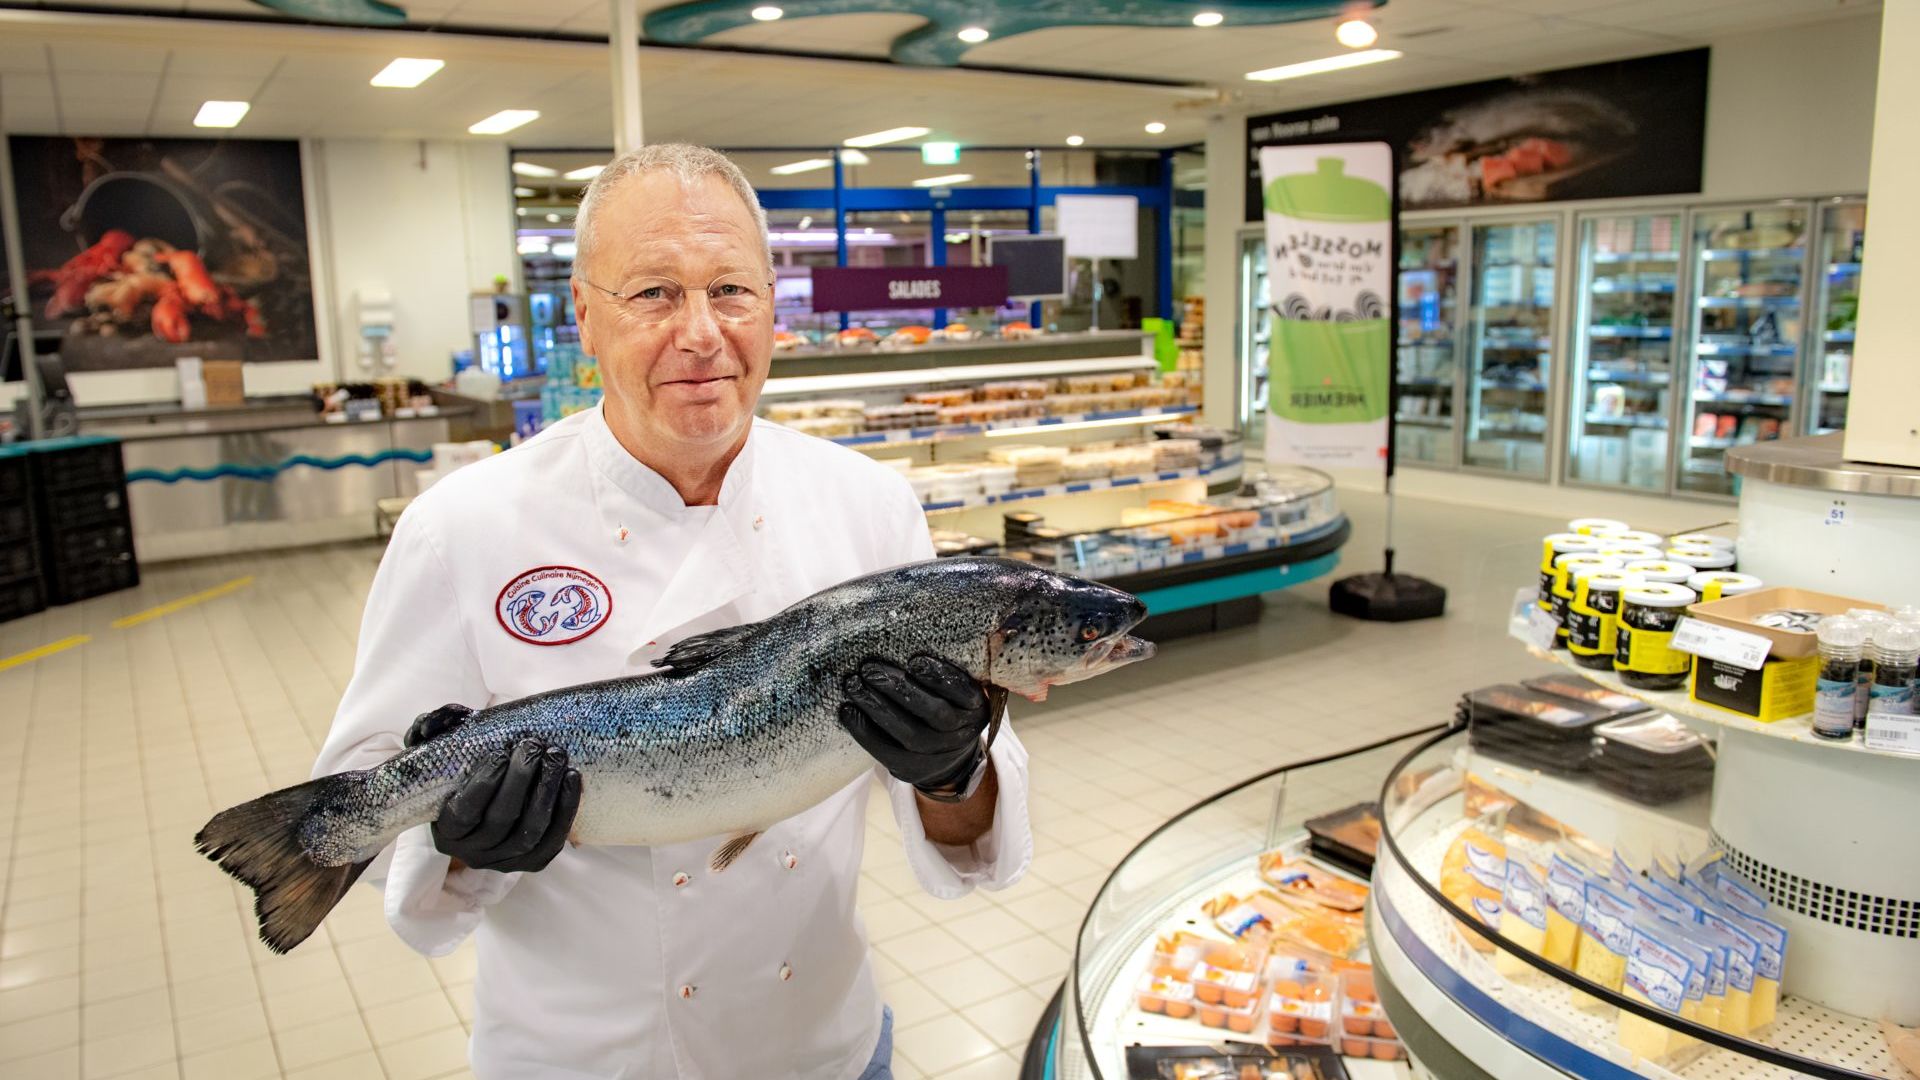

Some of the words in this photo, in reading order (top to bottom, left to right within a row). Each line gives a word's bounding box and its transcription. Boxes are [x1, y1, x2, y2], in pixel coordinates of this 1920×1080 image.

[888, 280, 941, 299] SALADES
[1831, 508, 1844, 520] 51
[508, 580, 530, 597] Cuisine
[532, 570, 563, 582] Culinaire
[566, 571, 599, 590] Nijmegen
